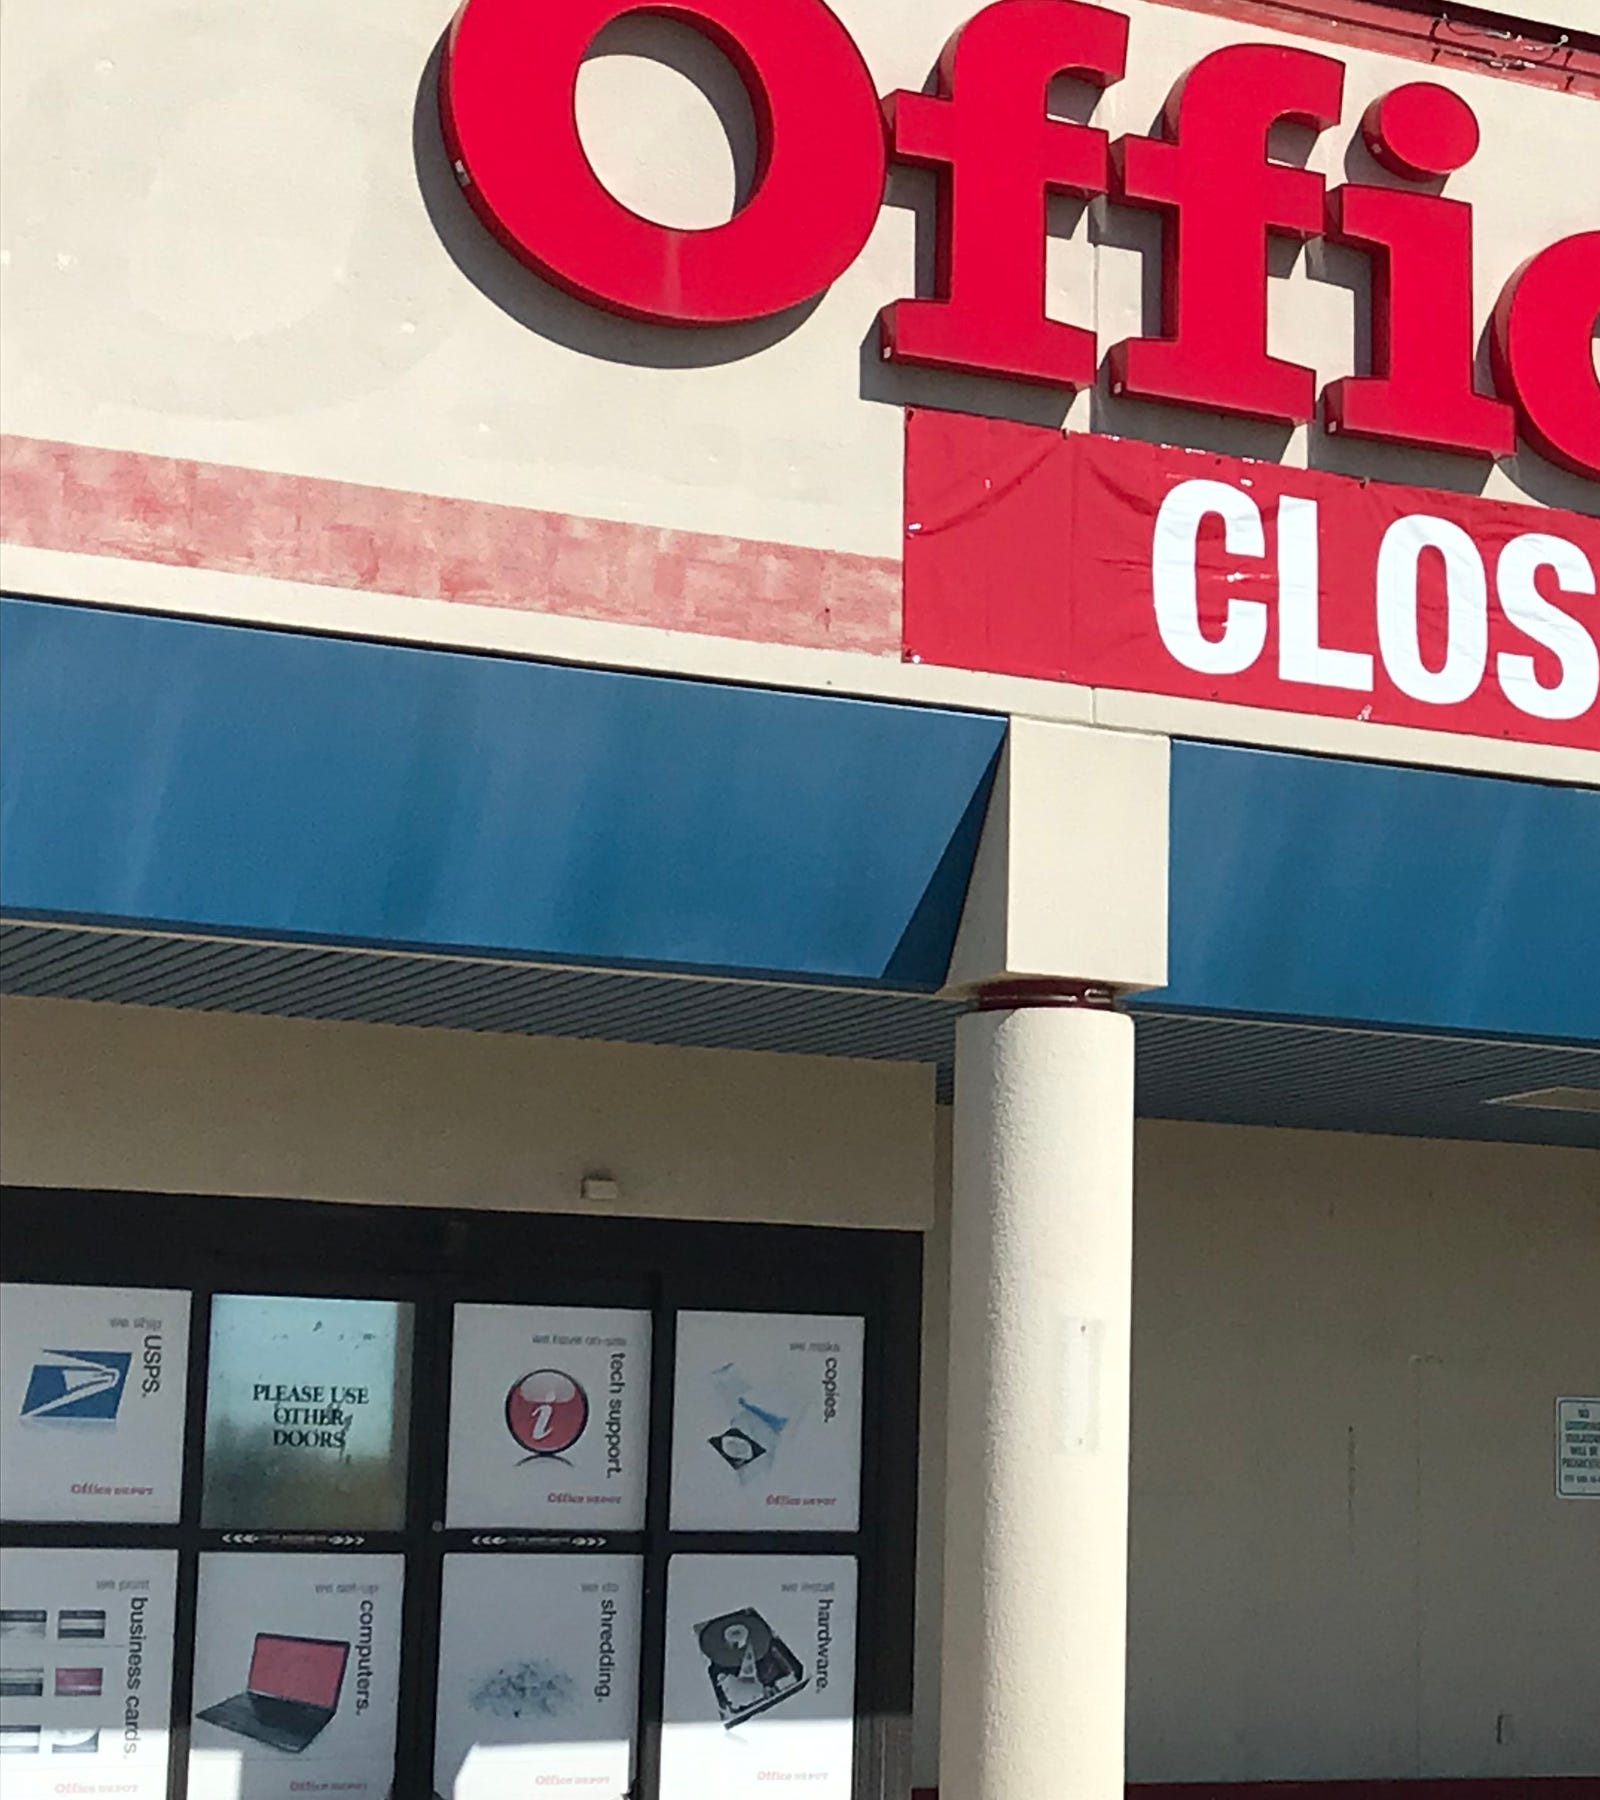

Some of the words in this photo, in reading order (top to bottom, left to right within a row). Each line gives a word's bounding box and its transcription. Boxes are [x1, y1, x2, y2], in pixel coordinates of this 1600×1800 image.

[253, 1383, 324, 1403] PLEASE
[331, 1385, 370, 1405] USE
[609, 1352, 626, 1394] tech
[822, 1357, 838, 1424] copies.
[273, 1407, 344, 1426] OTHER
[273, 1429, 346, 1448] DOORS
[125, 1597, 148, 1690] business
[355, 1599, 374, 1716] computers.
[594, 1599, 618, 1703] shredding.
[815, 1599, 834, 1695] hardware.
